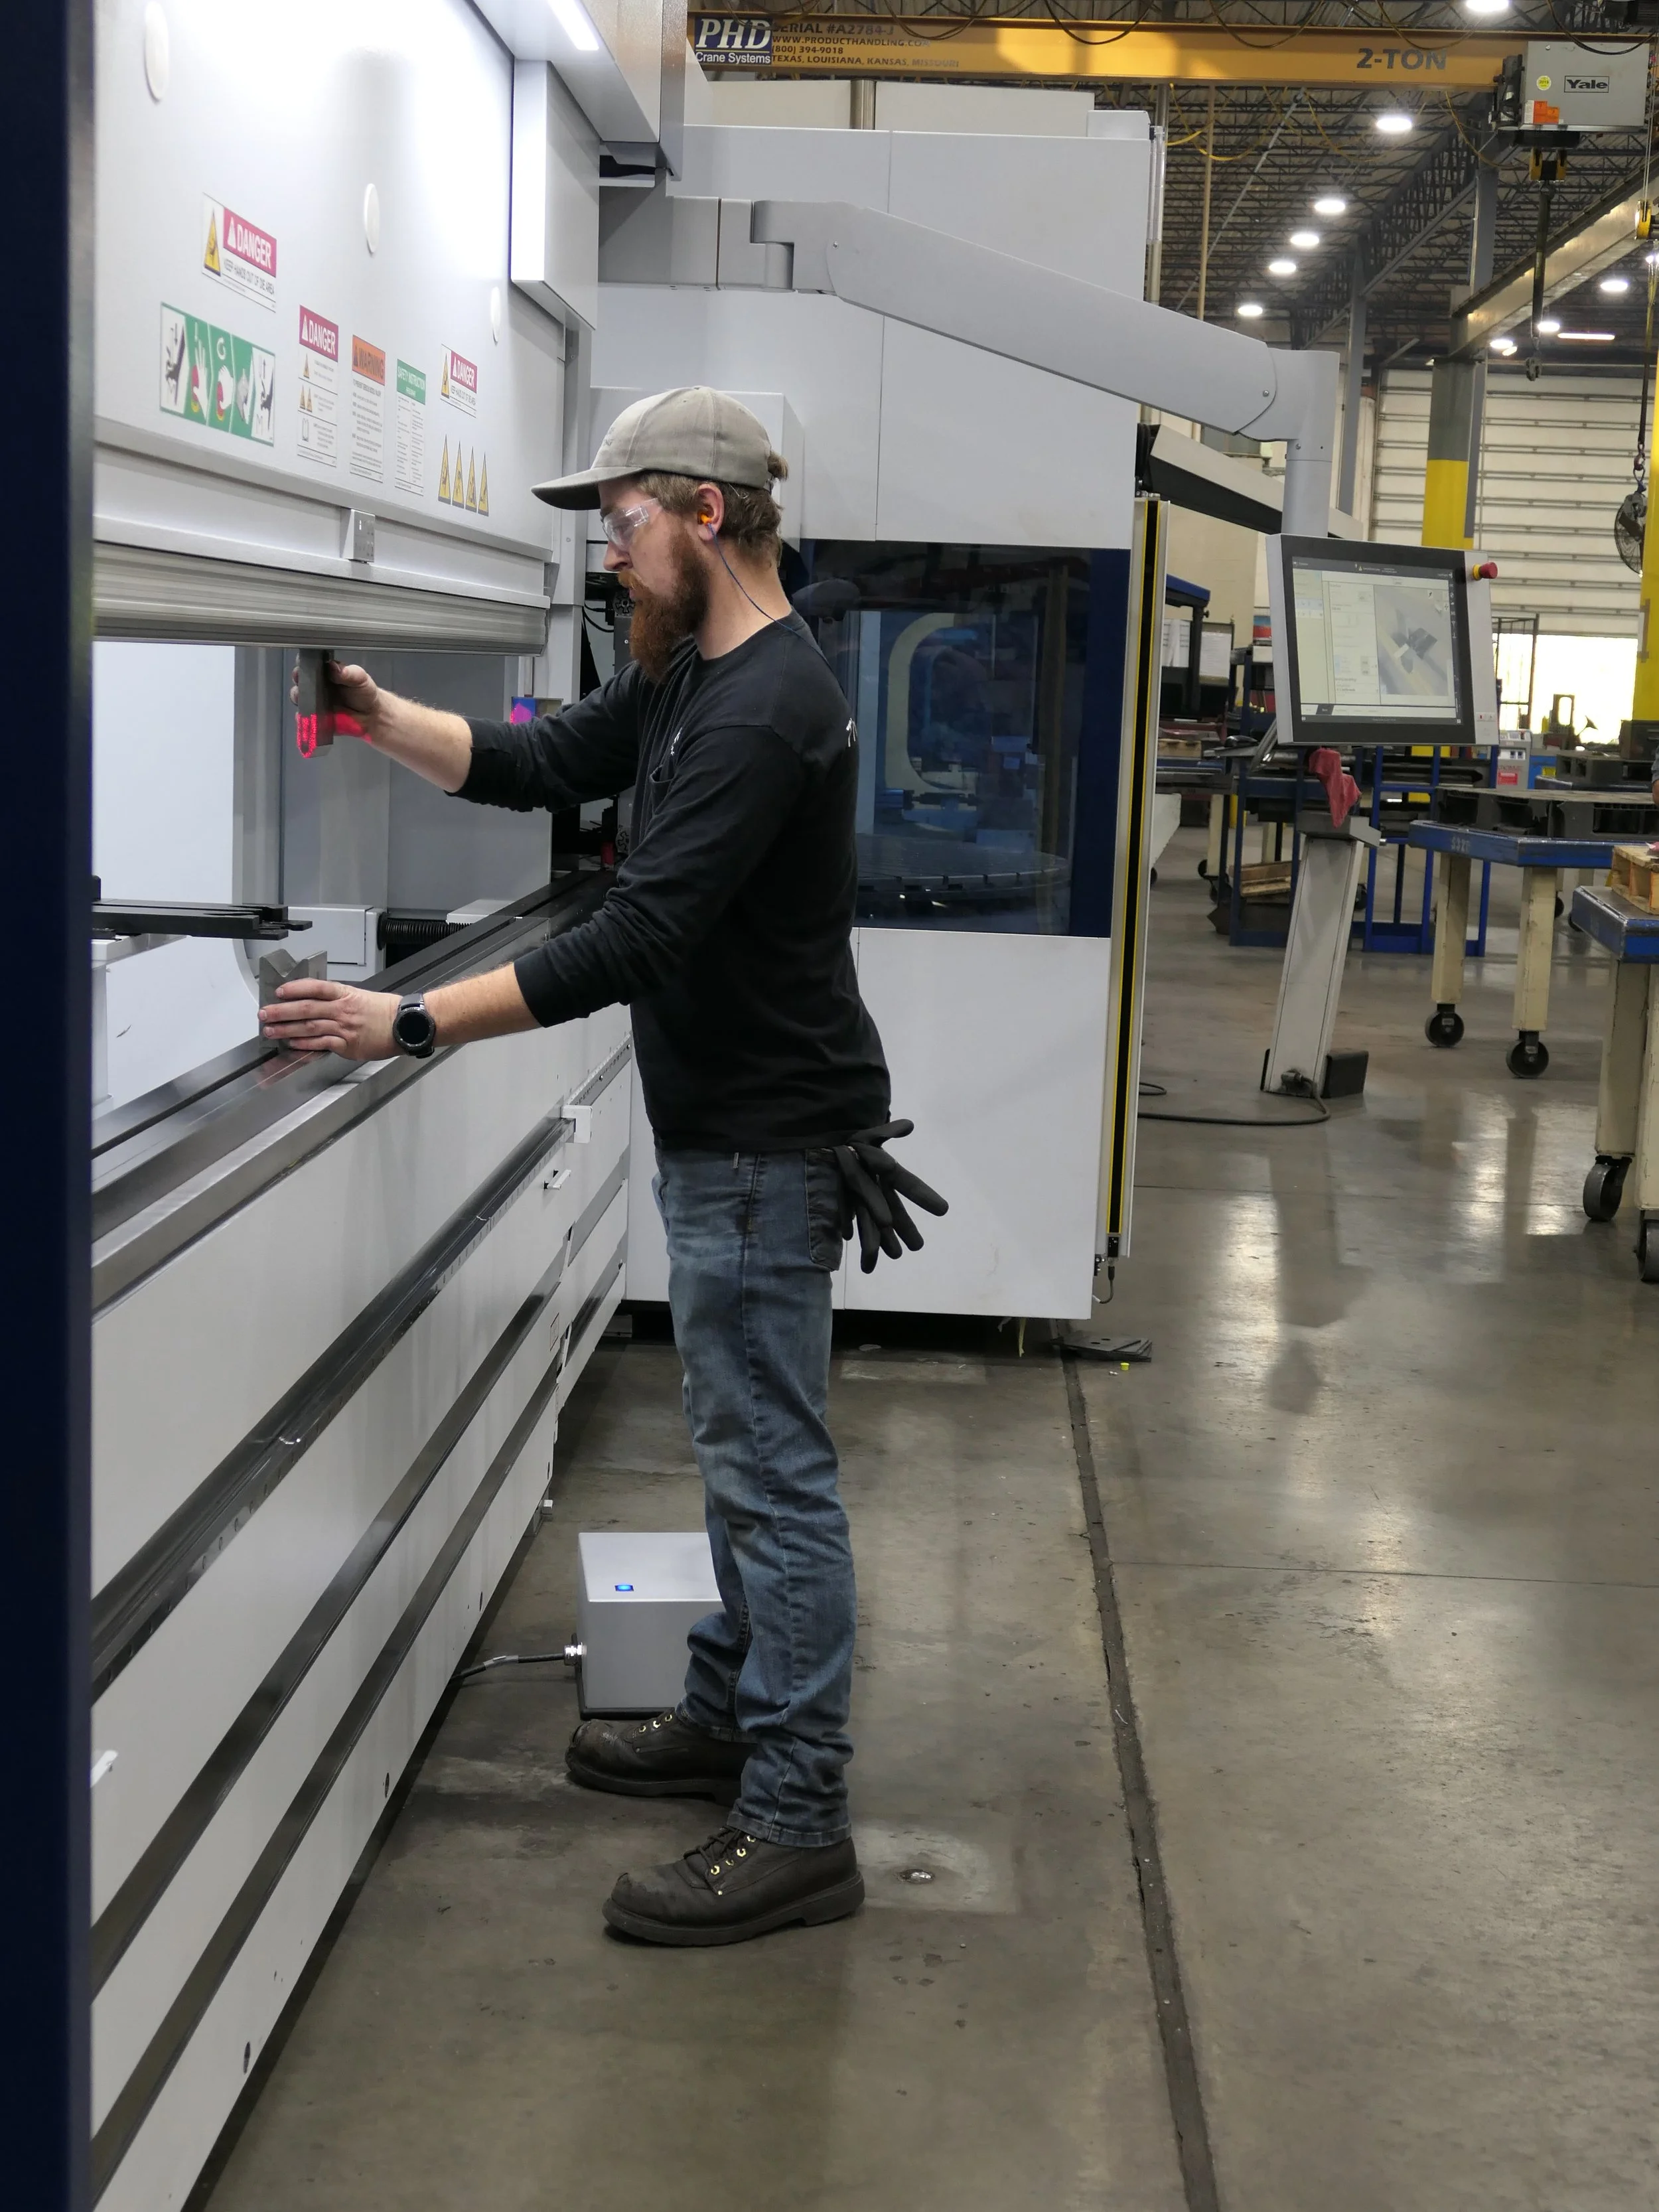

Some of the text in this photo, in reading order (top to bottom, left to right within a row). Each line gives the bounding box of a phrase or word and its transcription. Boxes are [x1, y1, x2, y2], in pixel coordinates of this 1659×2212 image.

[695, 19, 771, 49] PHD
[695, 51, 771, 64] Crane Systems
[772, 45, 796, 54] (800)
[772, 54, 805, 64] TEXAS,
[808, 56, 865, 65] LOUISIANA,
[867, 57, 909, 66] KANSAS,
[1356, 48, 1447, 70] 2-TON
[1567, 79, 1609, 89] Yale
[237, 224, 271, 269] DANGER
[309, 319, 336, 356] DANGER
[358, 346, 384, 380] WARNING
[457, 359, 475, 389] DANGER
